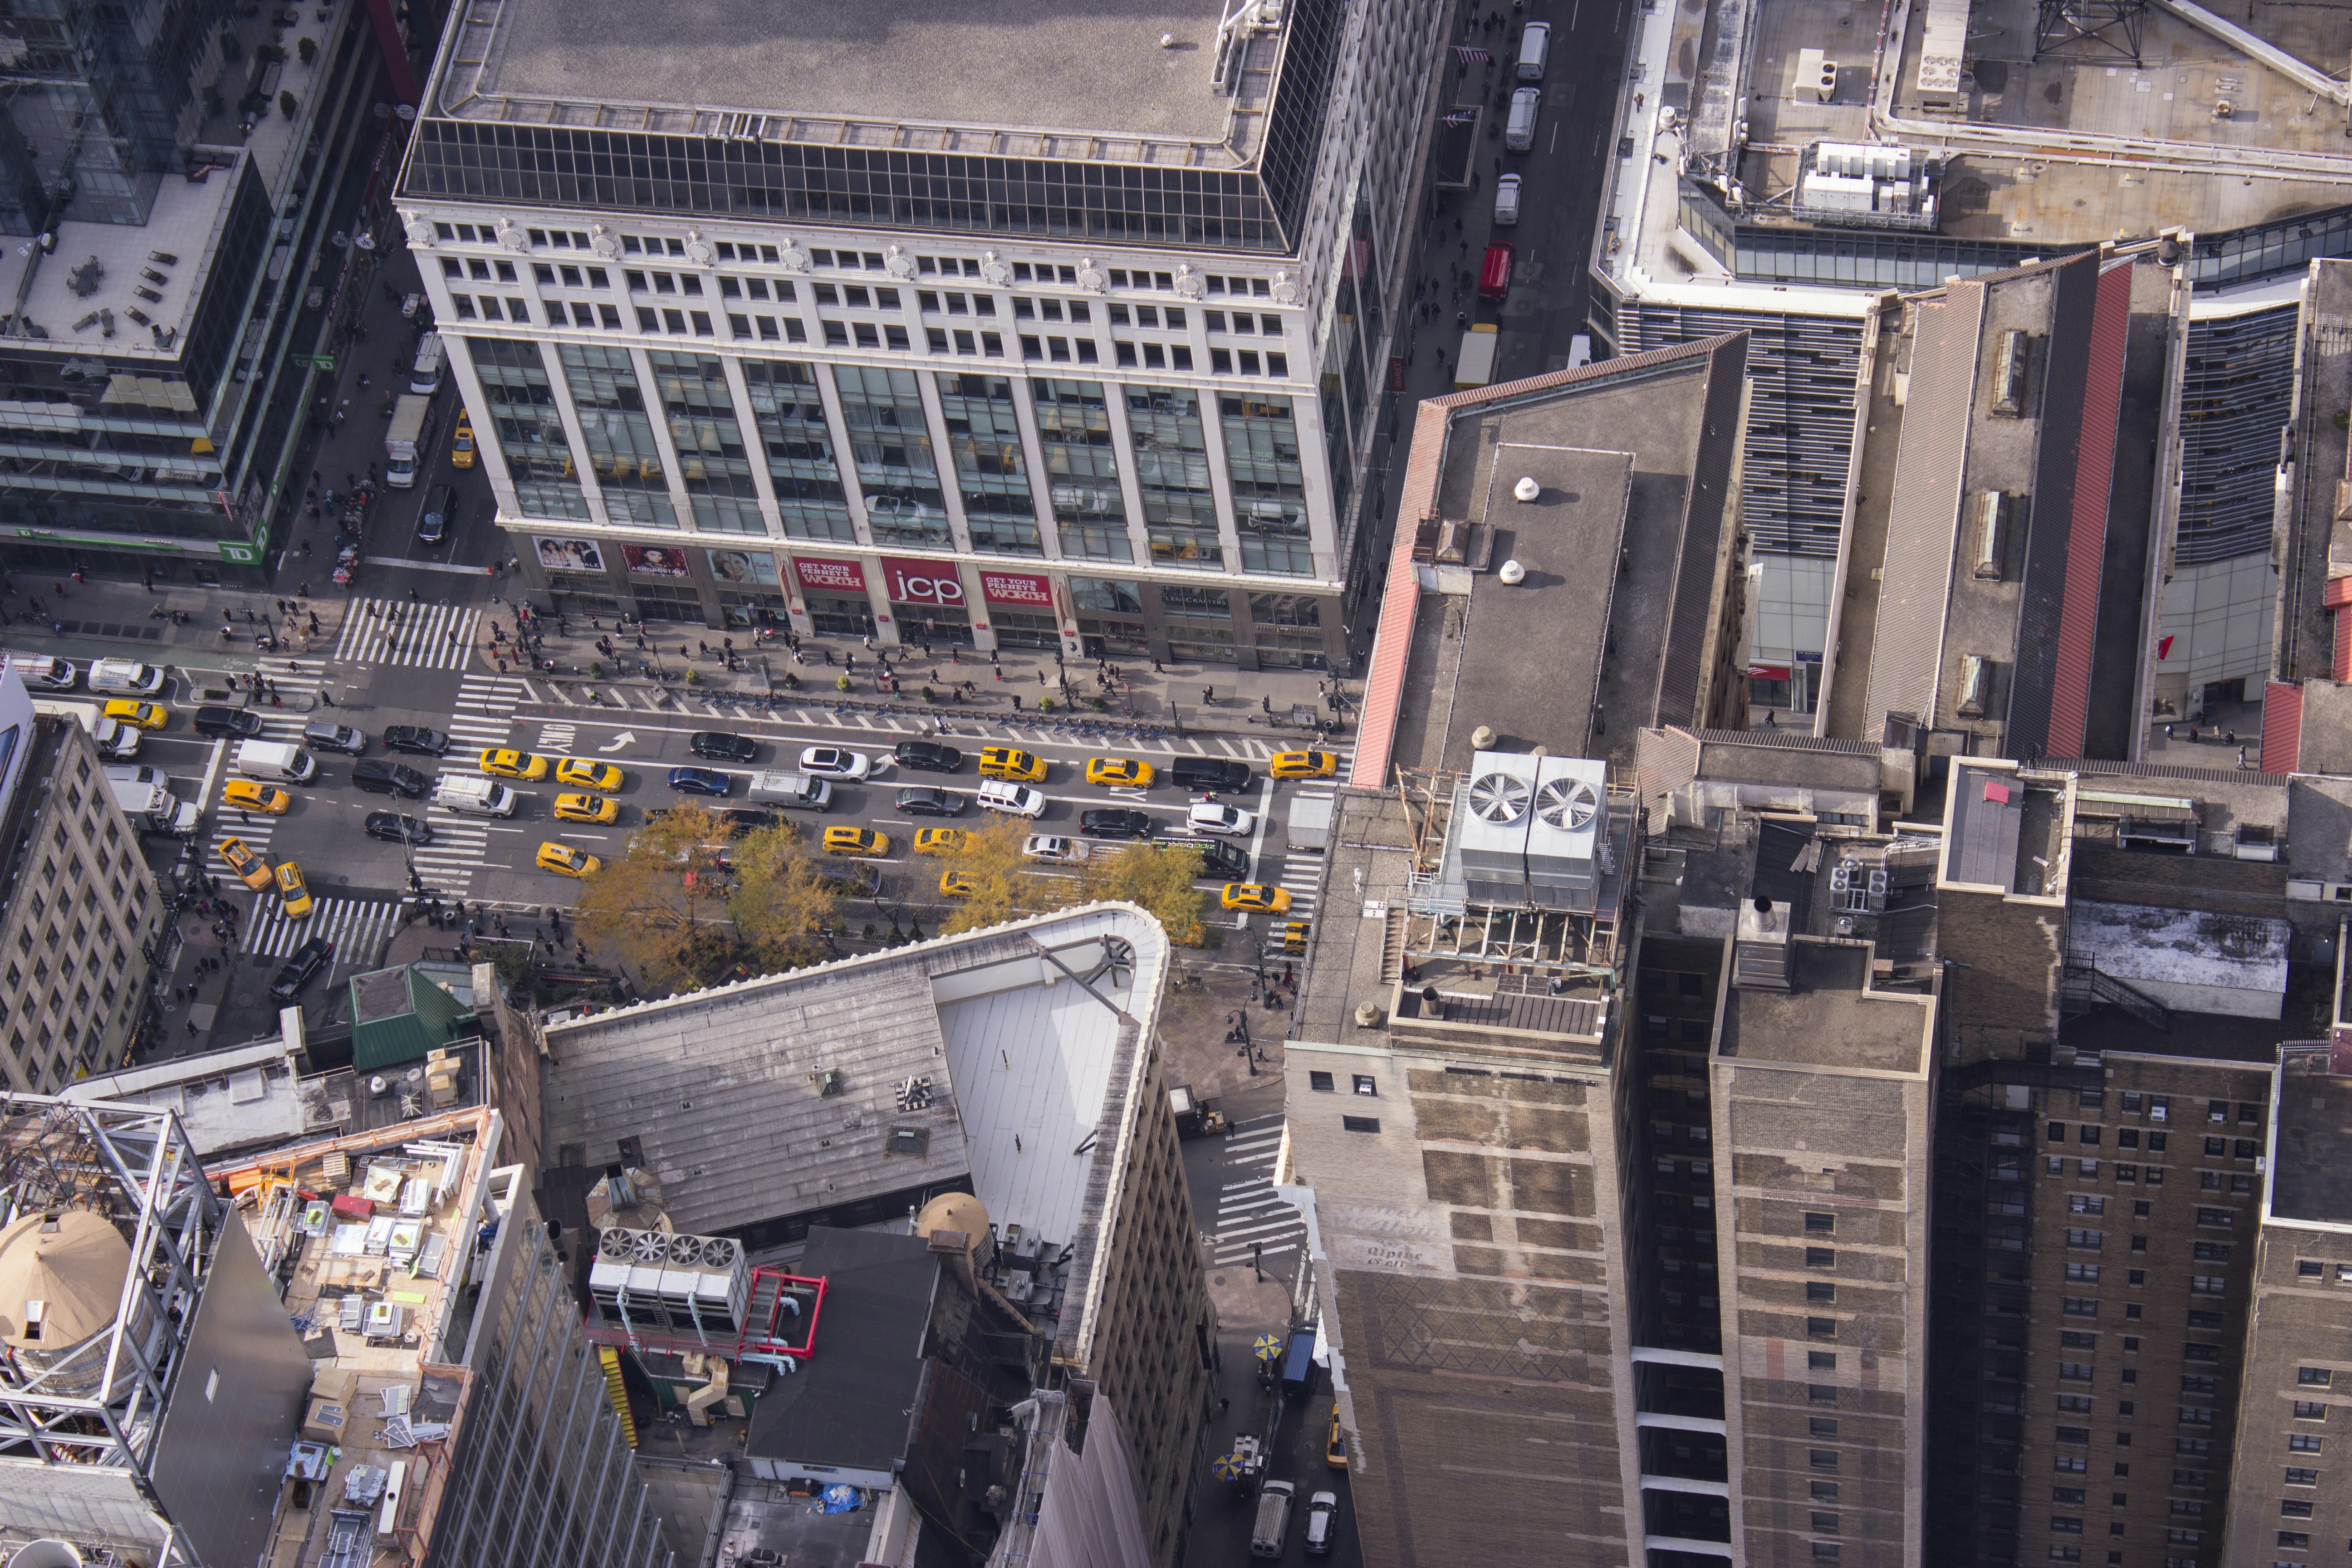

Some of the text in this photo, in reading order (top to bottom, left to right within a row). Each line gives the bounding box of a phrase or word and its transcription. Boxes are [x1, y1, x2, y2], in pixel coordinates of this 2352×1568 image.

[316, 361, 333, 369] TD
[256, 526, 267, 552] TD
[222, 547, 252, 560] TD
[800, 568, 849, 577] PENNEY'S
[802, 574, 862, 587] WORTH
[896, 569, 962, 604] jcp
[987, 582, 1036, 591] PENNEY'S
[988, 588, 1049, 601] WORTH
[536, 724, 576, 754] ONLY
